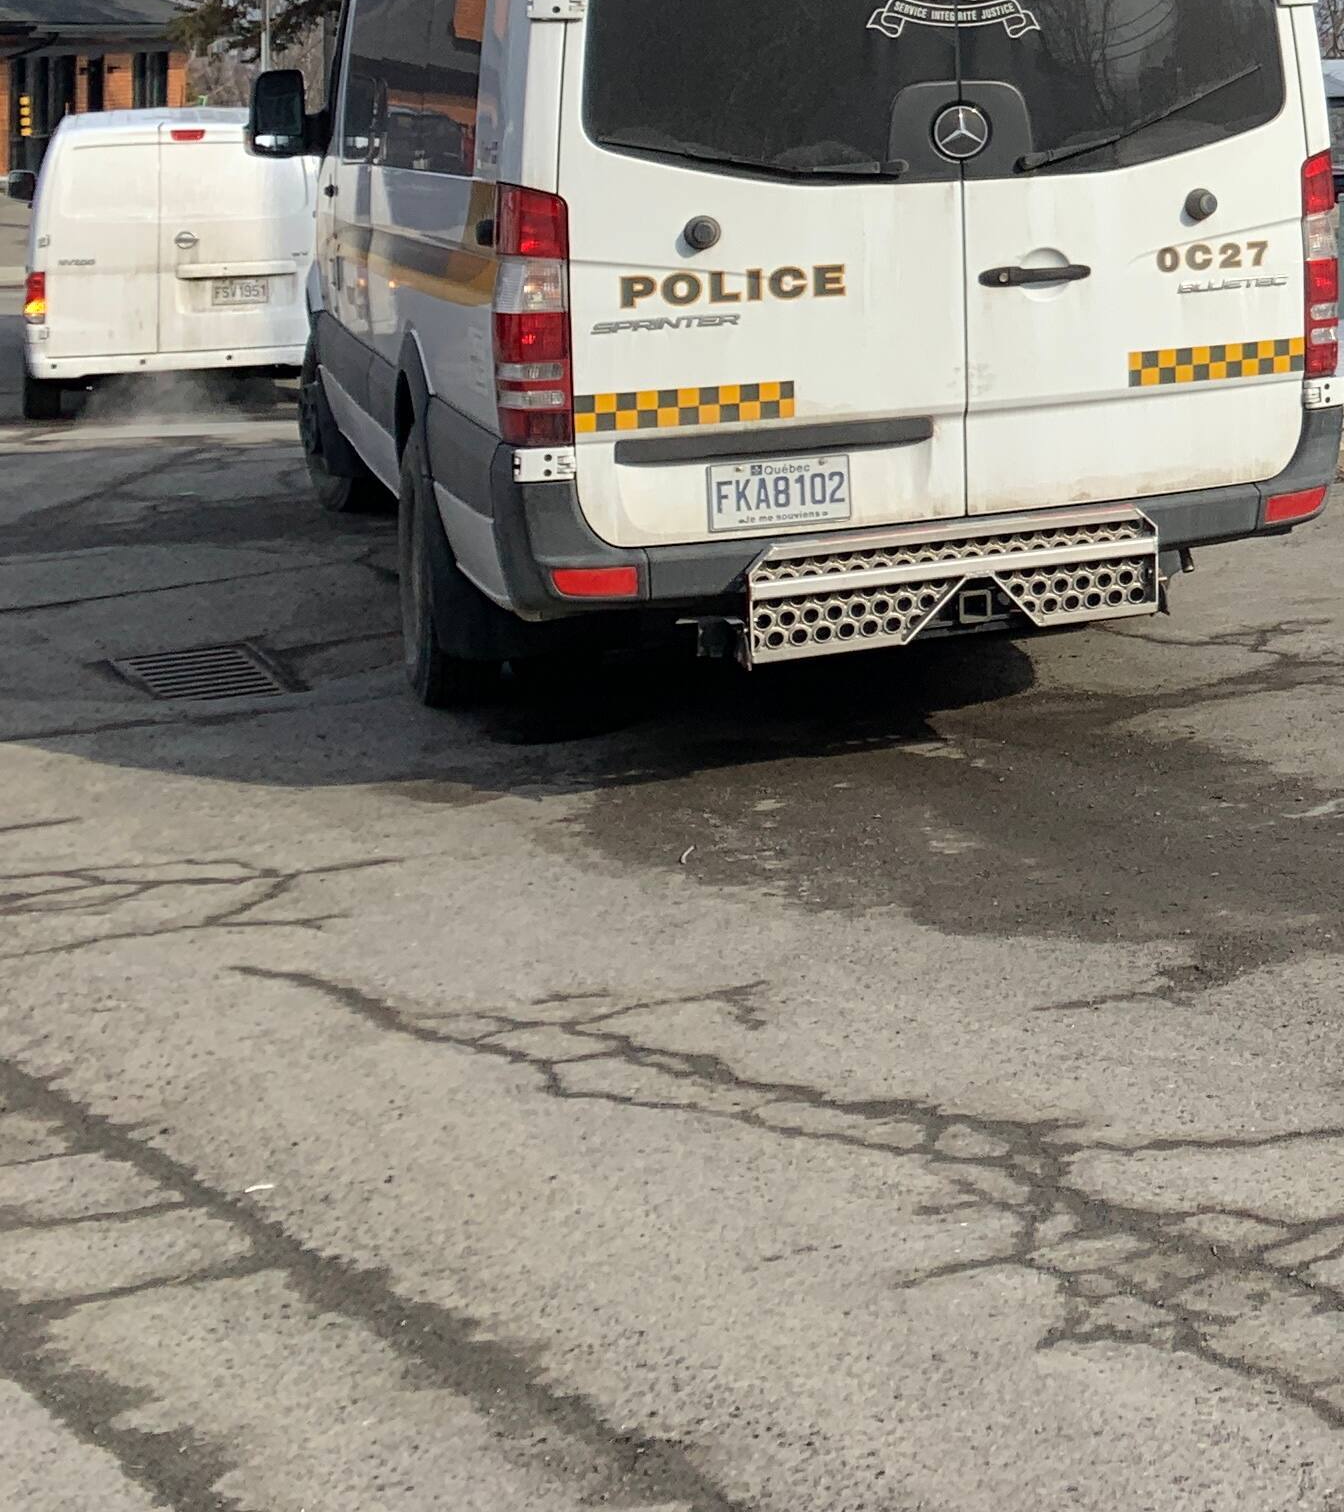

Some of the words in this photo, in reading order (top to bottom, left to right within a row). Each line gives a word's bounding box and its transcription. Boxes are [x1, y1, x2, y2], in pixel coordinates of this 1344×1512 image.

[893, 1, 928, 18] SERVICE
[981, 2, 1015, 19] JUSTICE
[619, 263, 846, 309] POLICE
[590, 313, 741, 335] SPRINTER
[764, 464, 810, 475] Québec
[716, 471, 845, 514] FKA8102
